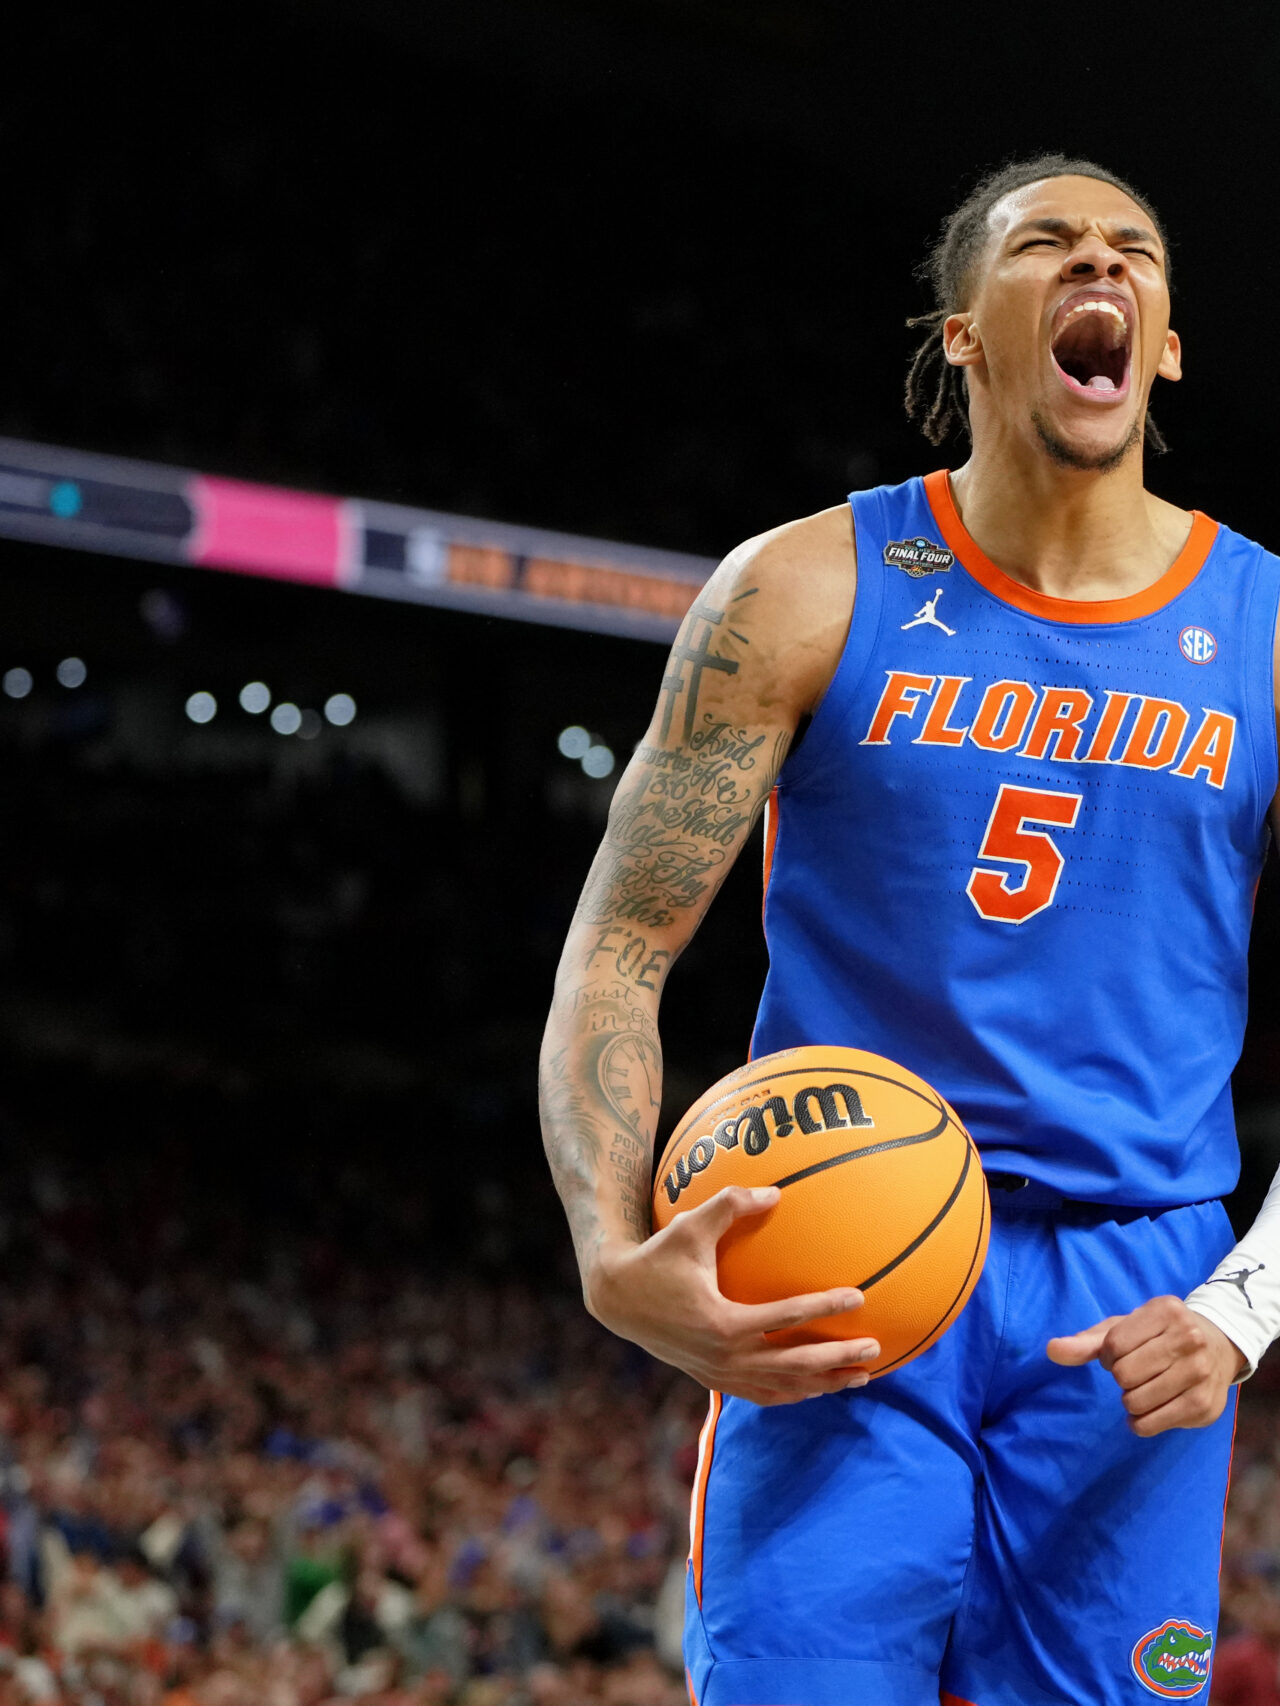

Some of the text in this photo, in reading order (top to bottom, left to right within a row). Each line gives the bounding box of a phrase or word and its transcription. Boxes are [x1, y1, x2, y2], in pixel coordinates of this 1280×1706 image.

[888, 547, 919, 560] FINAL
[920, 552, 951, 564] FOUR
[1182, 629, 1214, 661] SEC
[858, 671, 1236, 789] FLORIDA
[966, 783, 1083, 924] 5
[592, 1013, 622, 1032] in
[740, 1089, 771, 1106] EVO
[661, 1083, 875, 1206] Wilson
